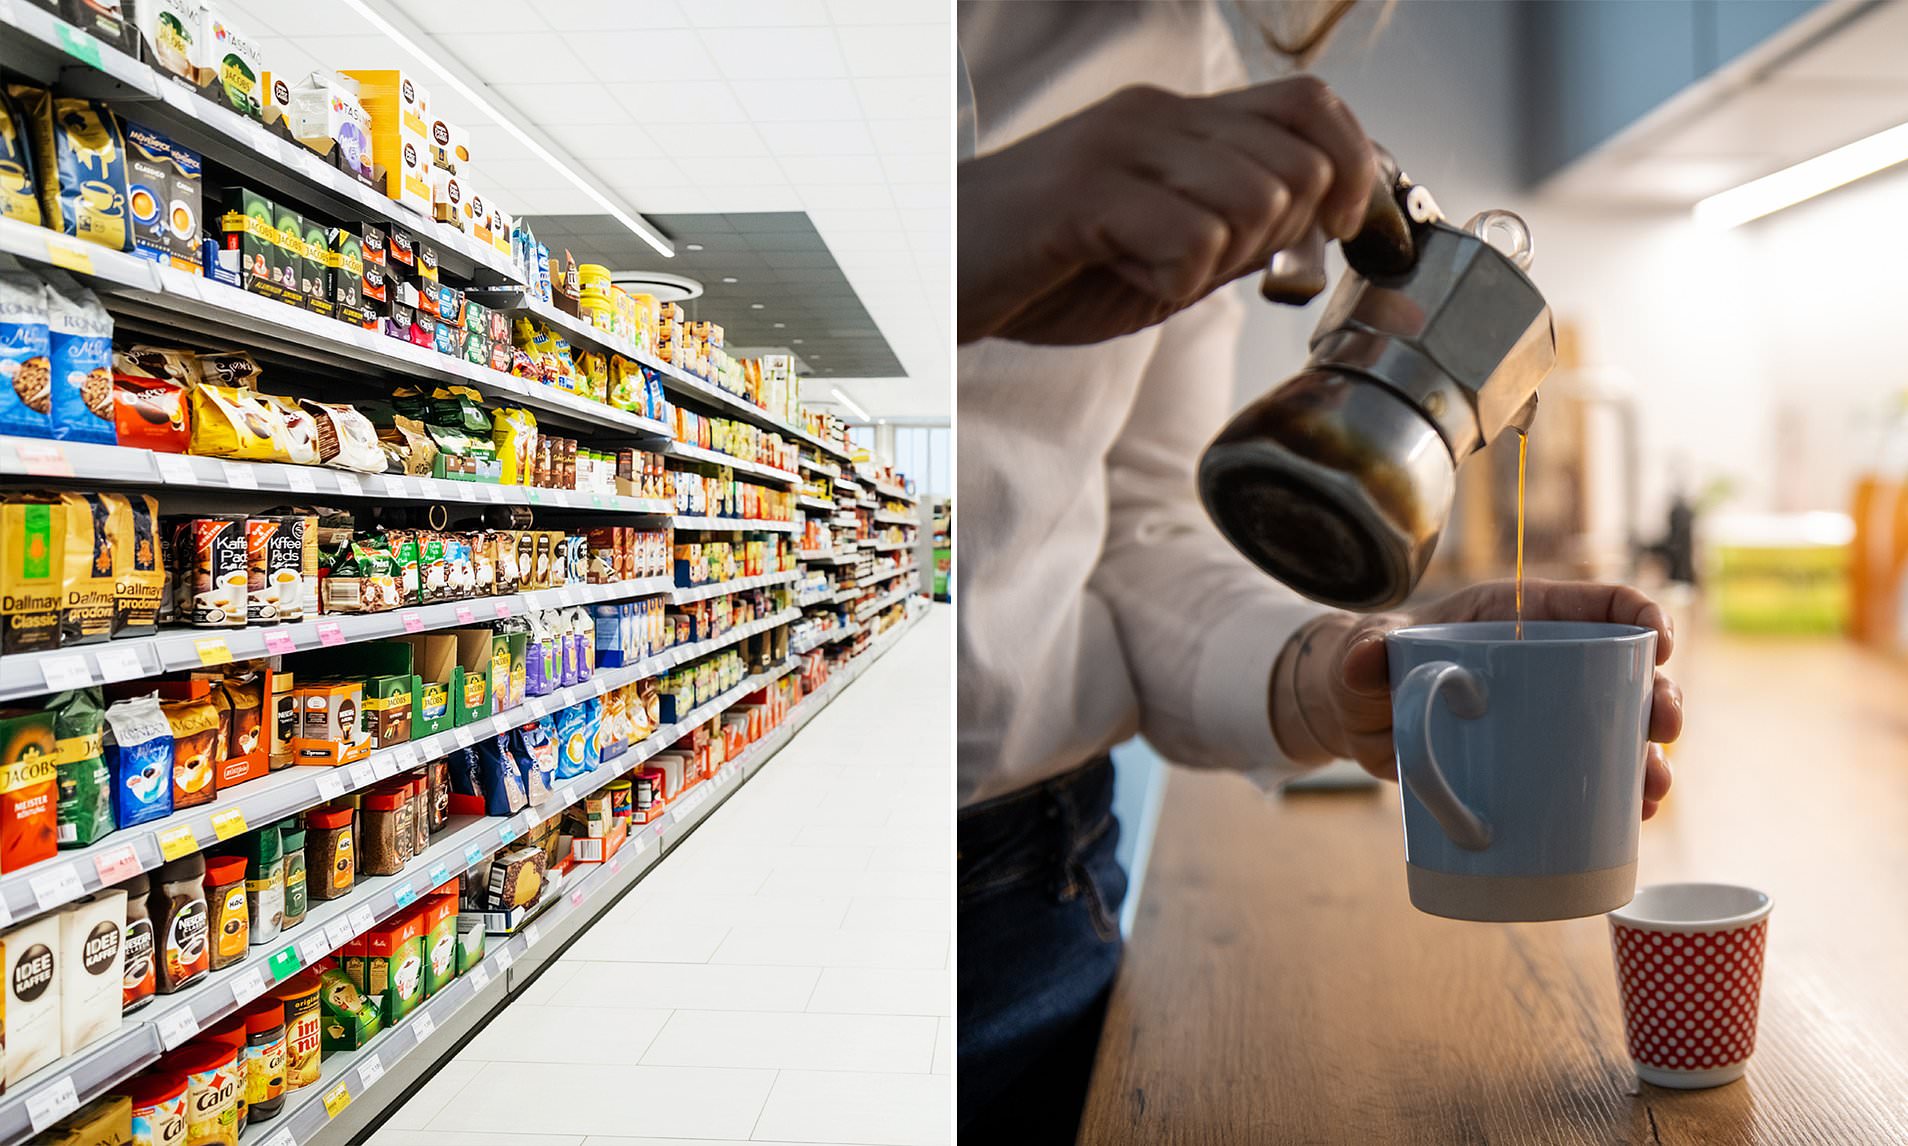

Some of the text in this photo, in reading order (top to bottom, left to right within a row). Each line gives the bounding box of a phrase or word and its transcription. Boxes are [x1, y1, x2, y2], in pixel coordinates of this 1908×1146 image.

[225, 69, 251, 92] JACOBS
[247, 219, 273, 240] JACOBS
[277, 232, 302, 251] JACOBS
[306, 245, 328, 263] JACOBS
[217, 536, 248, 550] Kaffe
[221, 550, 248, 563] Pad
[68, 591, 114, 605] Dallma
[115, 582, 163, 596] Dallmay
[11, 613, 59, 629] Classic
[68, 606, 114, 623] prodom
[387, 697, 407, 707] JACOBS
[424, 697, 443, 707] JACOBS
[2, 759, 57, 789] JACOBS
[14, 794, 48, 812] MEISTER
[85, 930, 119, 957] IDEE
[86, 947, 118, 968] KAFFEE
[15, 953, 52, 982] IDEE
[15, 969, 51, 994] KAFFEE
[297, 1018, 319, 1038] im
[297, 1033, 319, 1053] nu
[196, 1083, 233, 1112] Caro
[163, 1115, 185, 1141] Car
